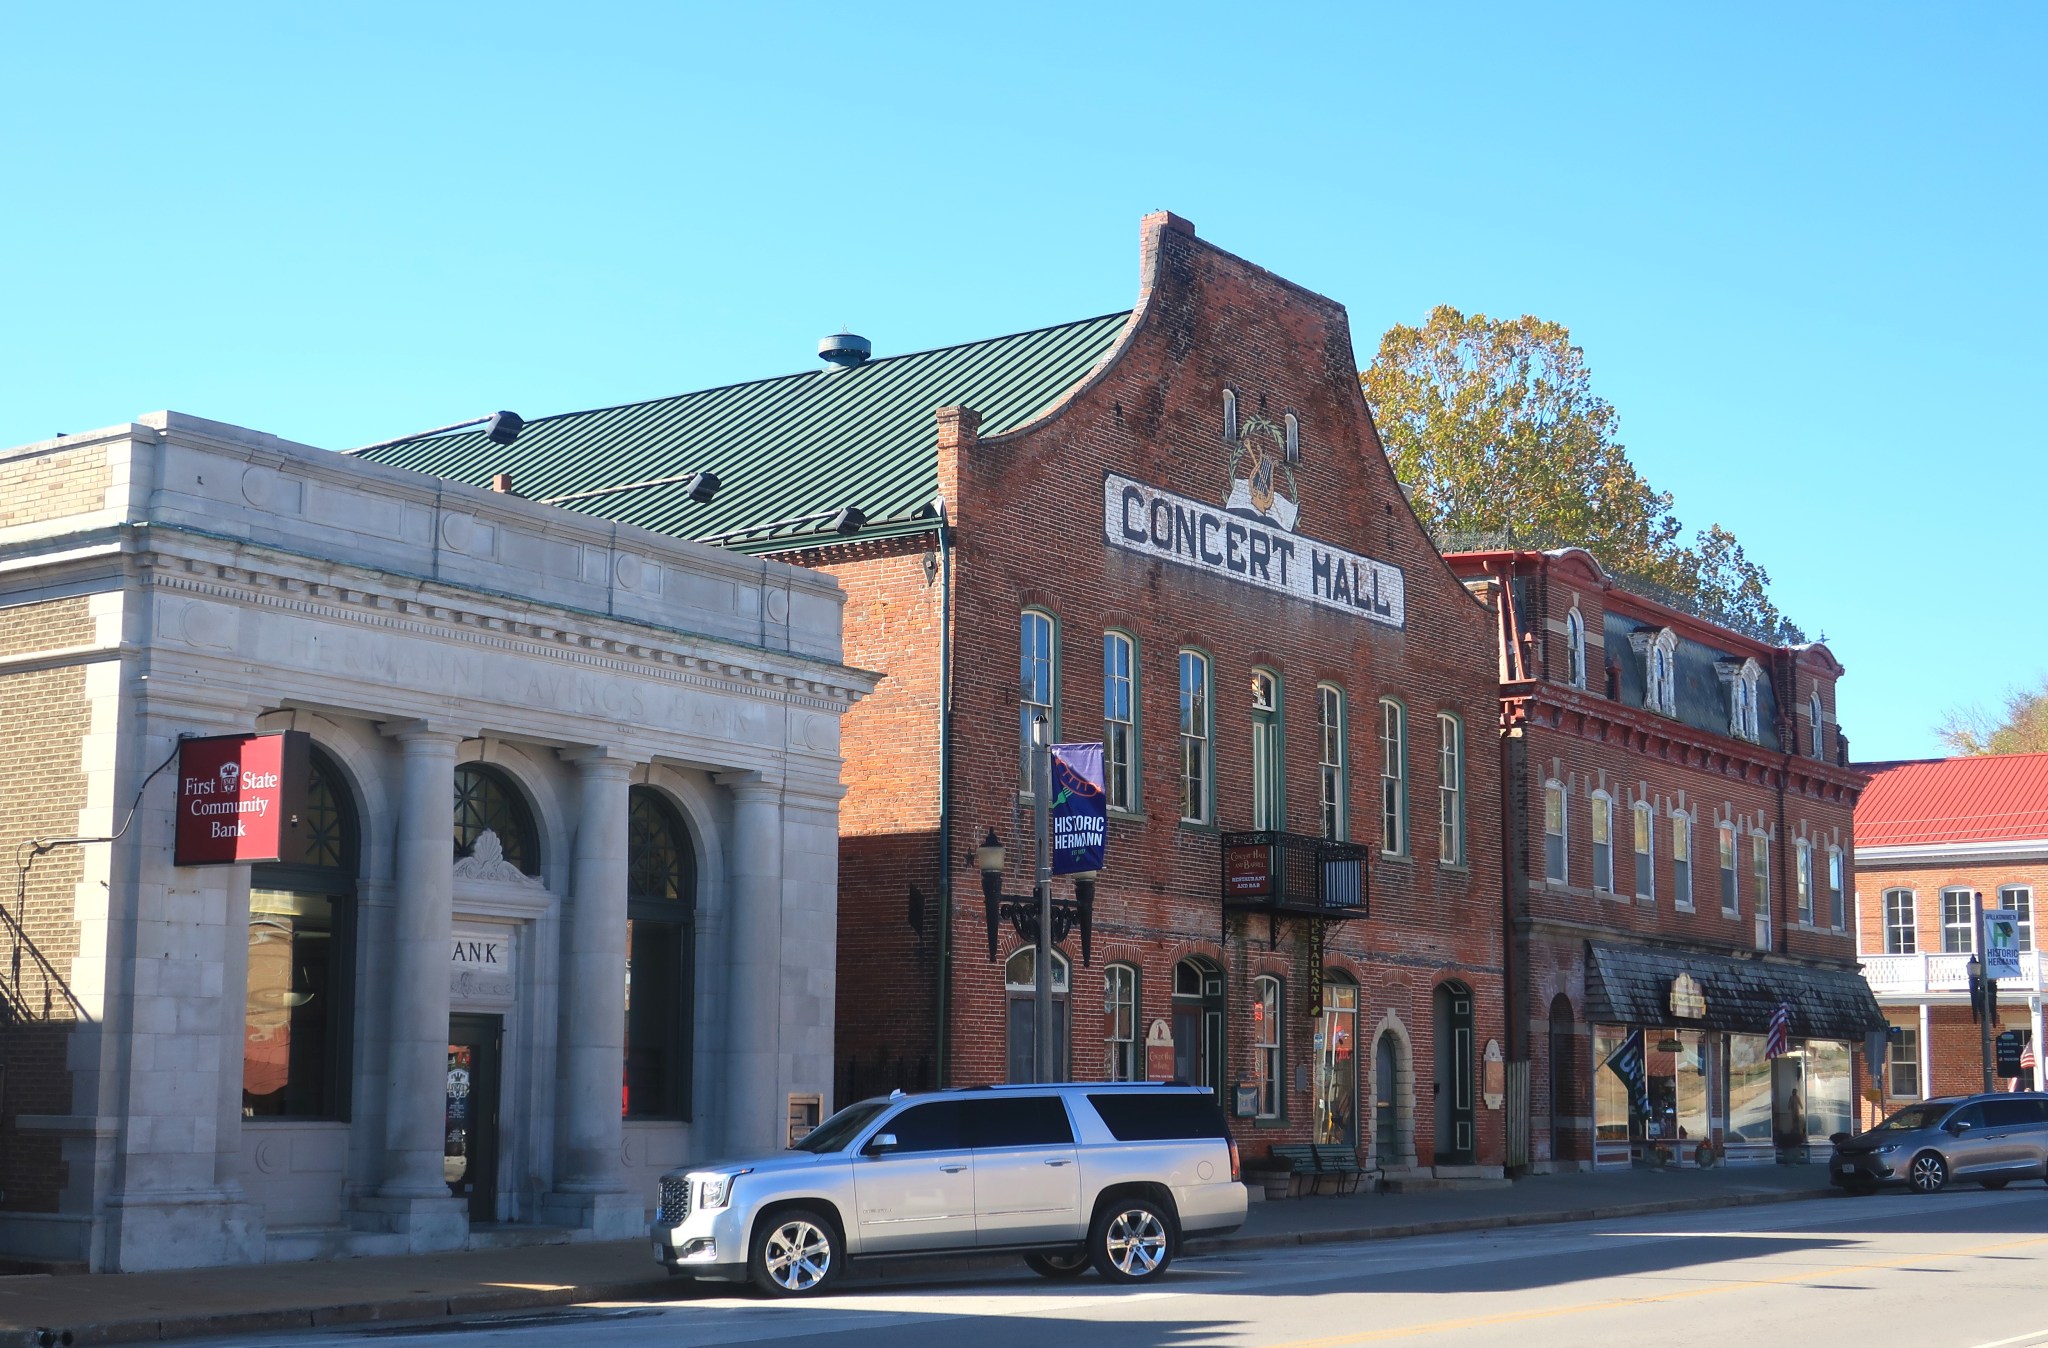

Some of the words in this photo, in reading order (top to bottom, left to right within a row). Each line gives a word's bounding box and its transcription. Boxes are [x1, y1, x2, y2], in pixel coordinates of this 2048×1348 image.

[1121, 485, 1295, 586] CONCERT
[1311, 548, 1391, 617] HALL
[289, 626, 471, 685] HERMANN
[504, 668, 645, 717] SAVINGS
[672, 694, 750, 733] BANK
[184, 778, 216, 796] First
[241, 771, 278, 790] State
[190, 796, 269, 817] Community
[211, 820, 247, 838] Bank
[1054, 815, 1105, 833] HISTORIC
[1054, 832, 1103, 850] HERMANN
[451, 941, 497, 963] ANK
[1310, 918, 1322, 1002] RESTAURANT
[1987, 948, 2019, 958] HISTORIC
[1988, 957, 2019, 967] HERMANN
